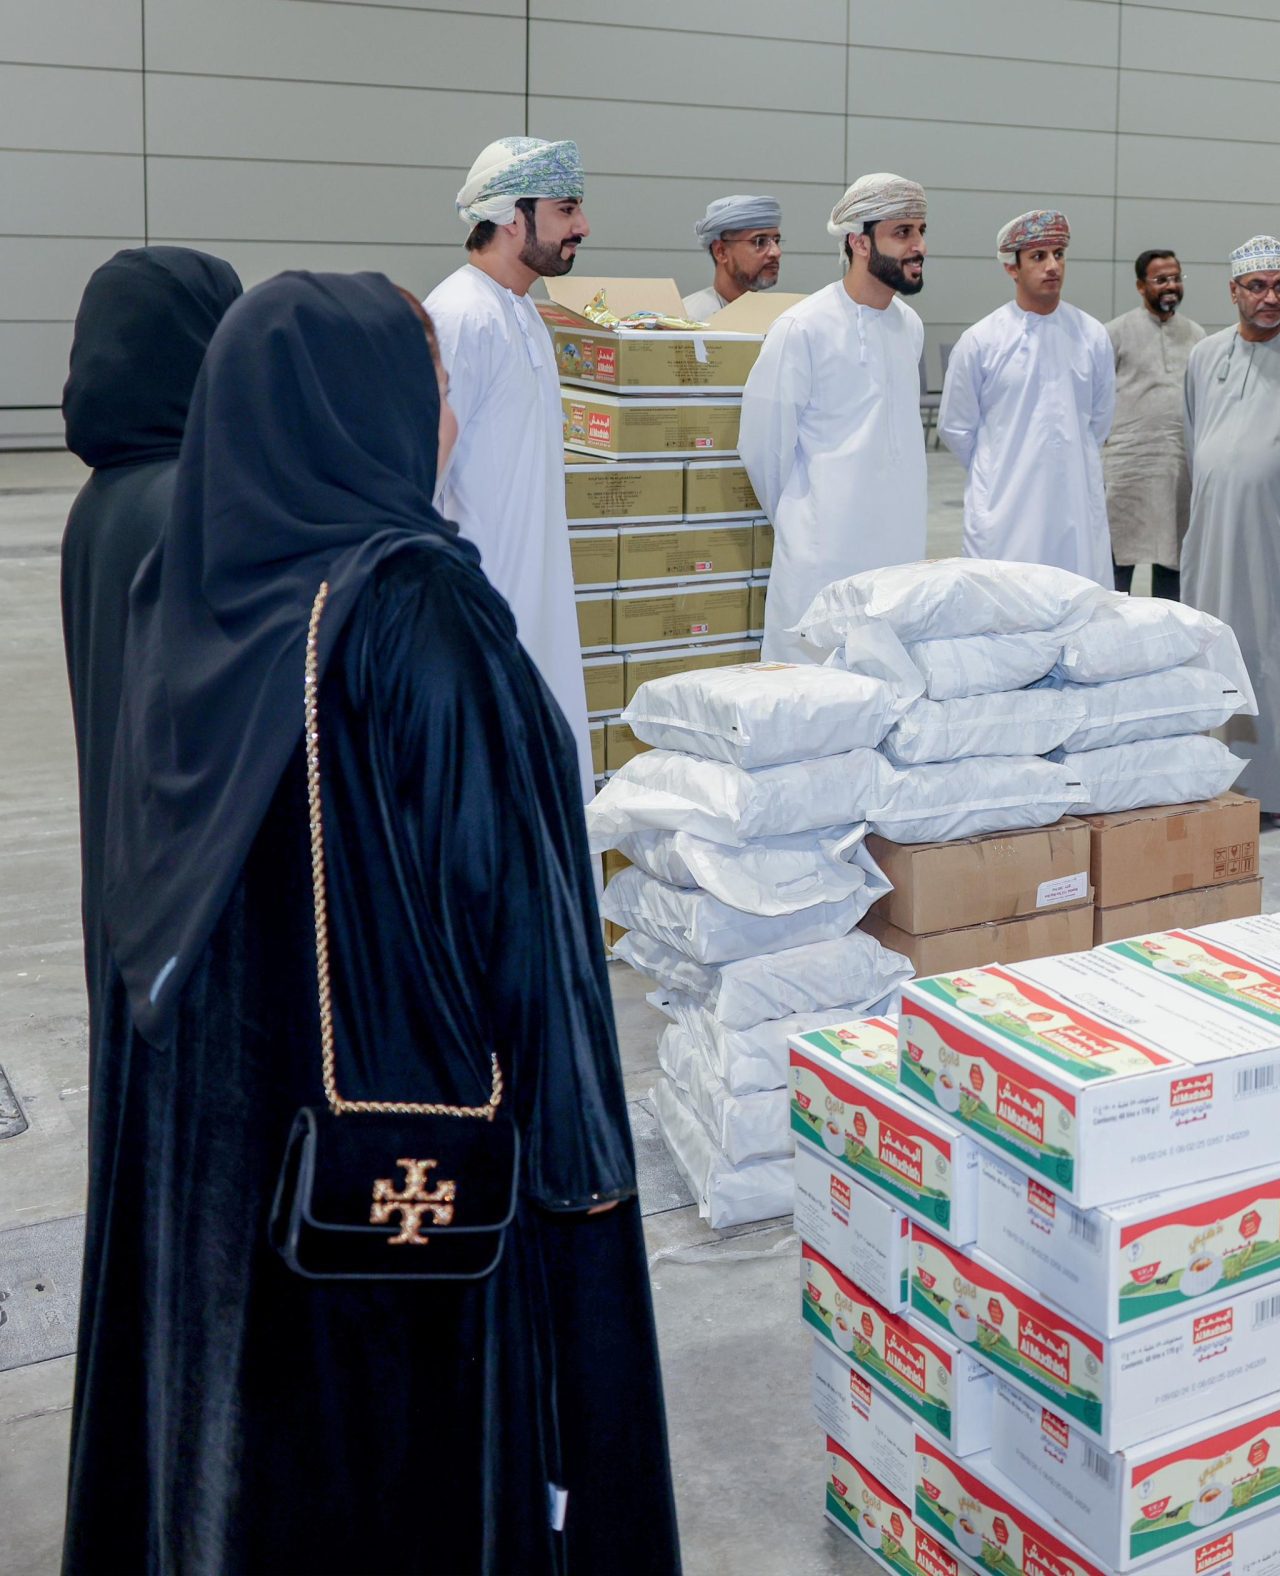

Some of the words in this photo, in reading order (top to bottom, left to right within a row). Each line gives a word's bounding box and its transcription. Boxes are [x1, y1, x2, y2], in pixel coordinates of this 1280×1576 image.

[824, 1096, 845, 1117] Gold
[999, 1082, 1042, 1119] المدهش
[881, 1130, 921, 1164] المدهش
[834, 1292, 853, 1312] Gold
[953, 1277, 977, 1299] Gold
[886, 1335, 923, 1371] المدهش
[1020, 1321, 1067, 1361] المدهش
[861, 1489, 881, 1511] Gold
